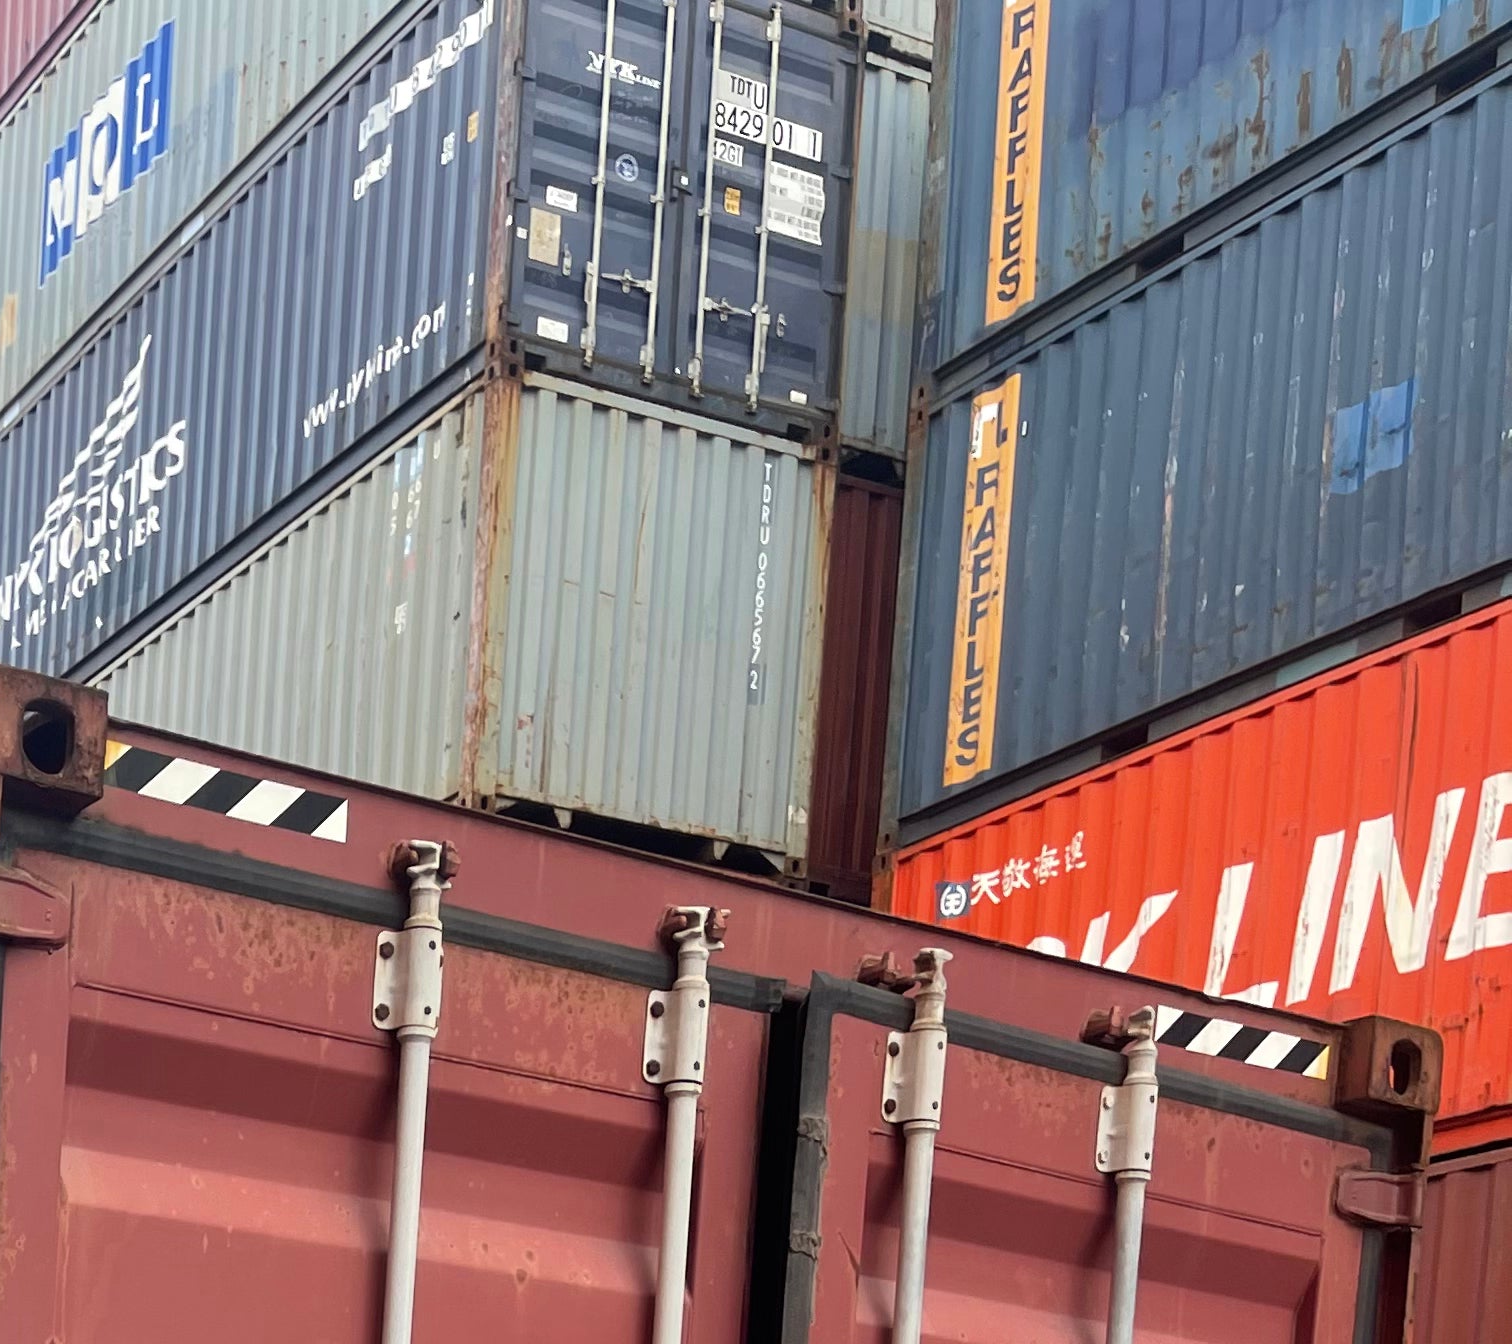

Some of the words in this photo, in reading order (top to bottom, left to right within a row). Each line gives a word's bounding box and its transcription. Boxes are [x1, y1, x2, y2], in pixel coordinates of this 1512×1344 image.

[997, 6, 1035, 302] RAFFLES
[759, 463, 773, 545] TDRU
[955, 464, 1001, 767] RAFFLES
[1204, 770, 1512, 1009] LINE
